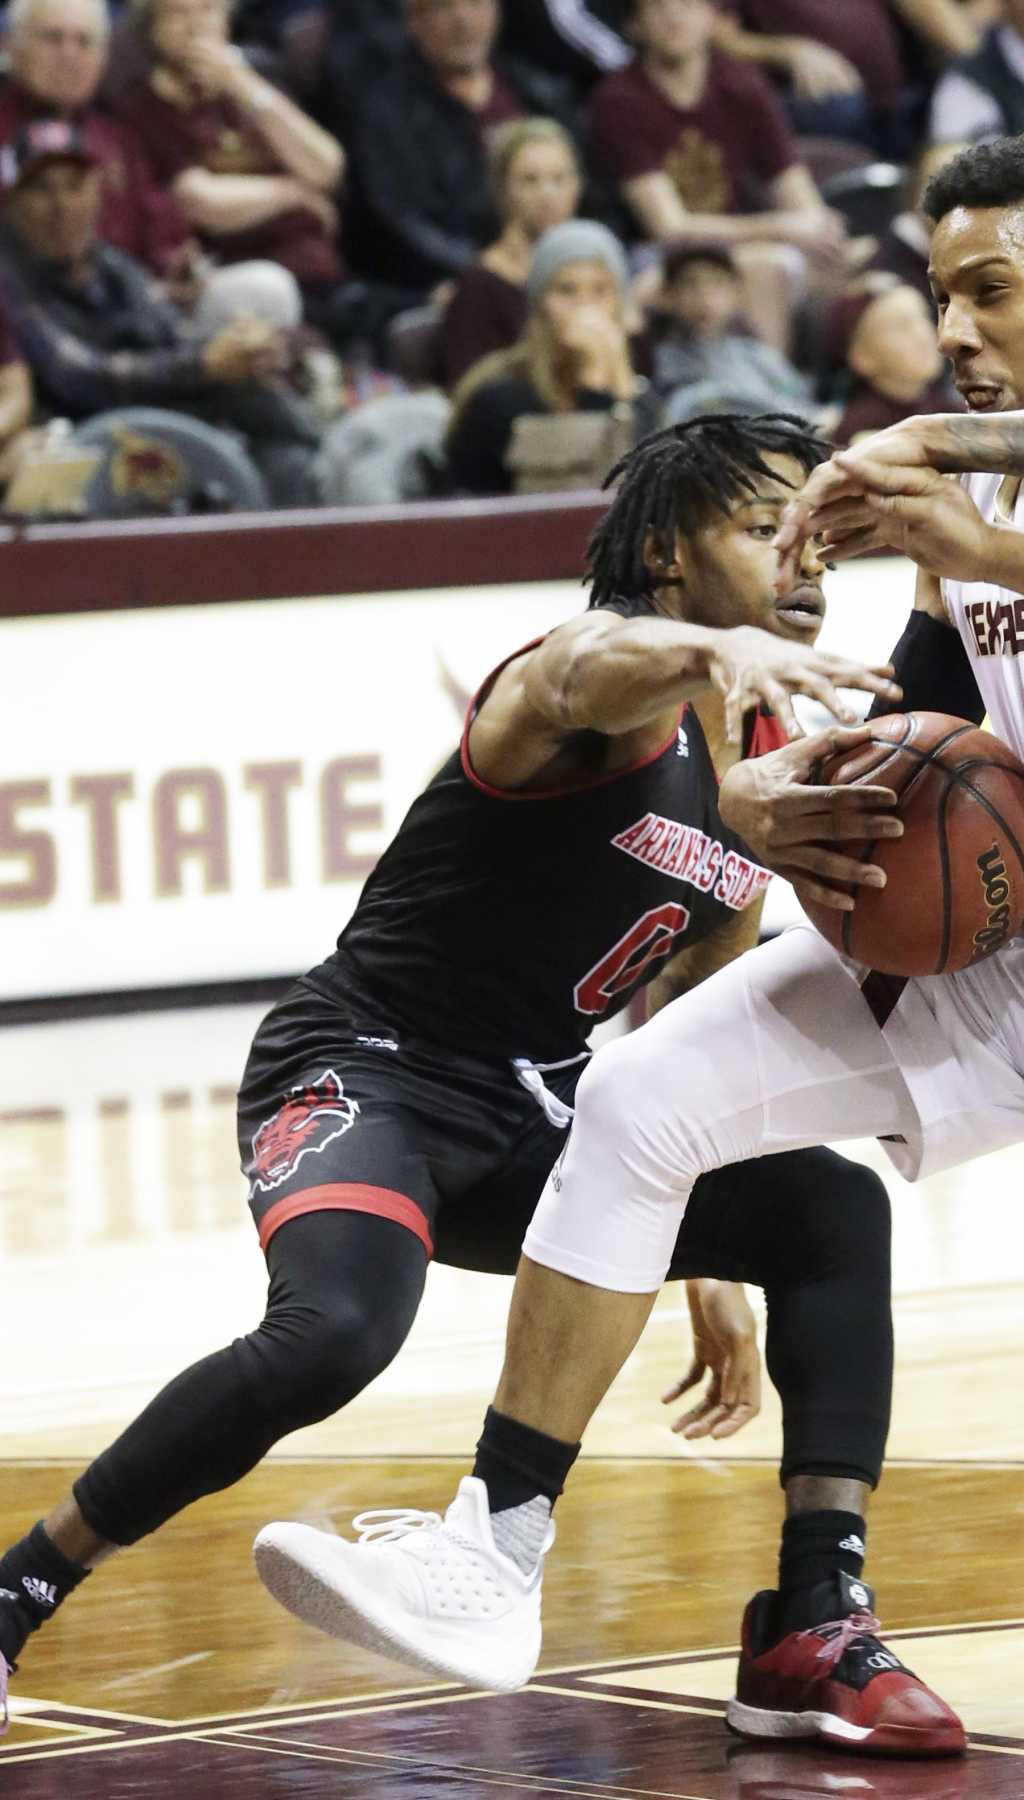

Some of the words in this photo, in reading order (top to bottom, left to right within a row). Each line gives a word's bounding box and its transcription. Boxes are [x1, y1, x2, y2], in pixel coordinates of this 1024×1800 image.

[0, 753, 384, 911] STATE
[714, 850, 776, 911] STA
[971, 841, 1010, 956] ilson
[573, 901, 690, 1014] 0
